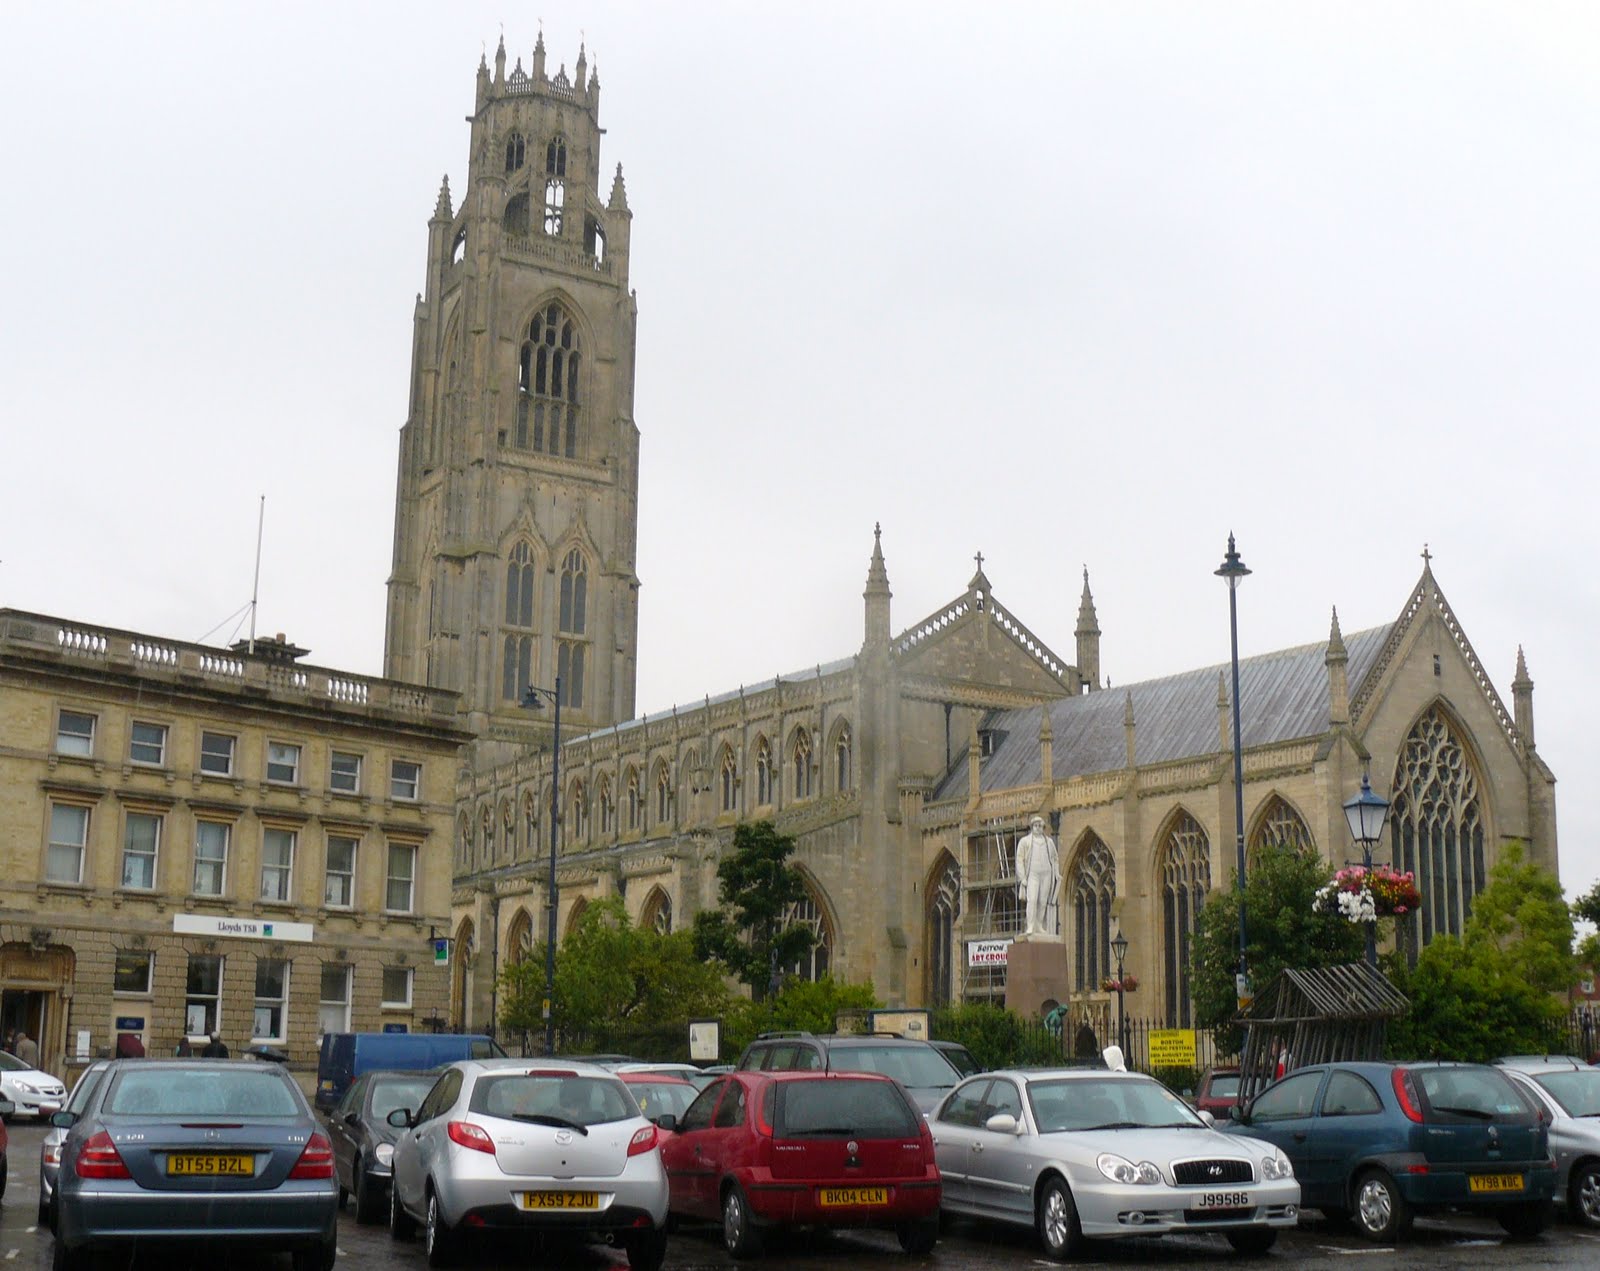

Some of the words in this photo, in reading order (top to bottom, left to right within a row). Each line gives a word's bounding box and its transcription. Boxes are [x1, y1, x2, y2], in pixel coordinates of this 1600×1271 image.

[218, 921, 242, 934] Lloyds
[243, 924, 258, 933] TSB
[971, 953, 985, 961] ART
[175, 1158, 214, 1172] BT55
[218, 1159, 247, 1172] BZL
[1473, 1175, 1499, 1189] Y798
[529, 1193, 563, 1207] FX59
[568, 1192, 593, 1207] ZJU
[826, 1191, 857, 1203] BK04
[860, 1190, 883, 1202] CLN
[1199, 1193, 1248, 1206] J99586
